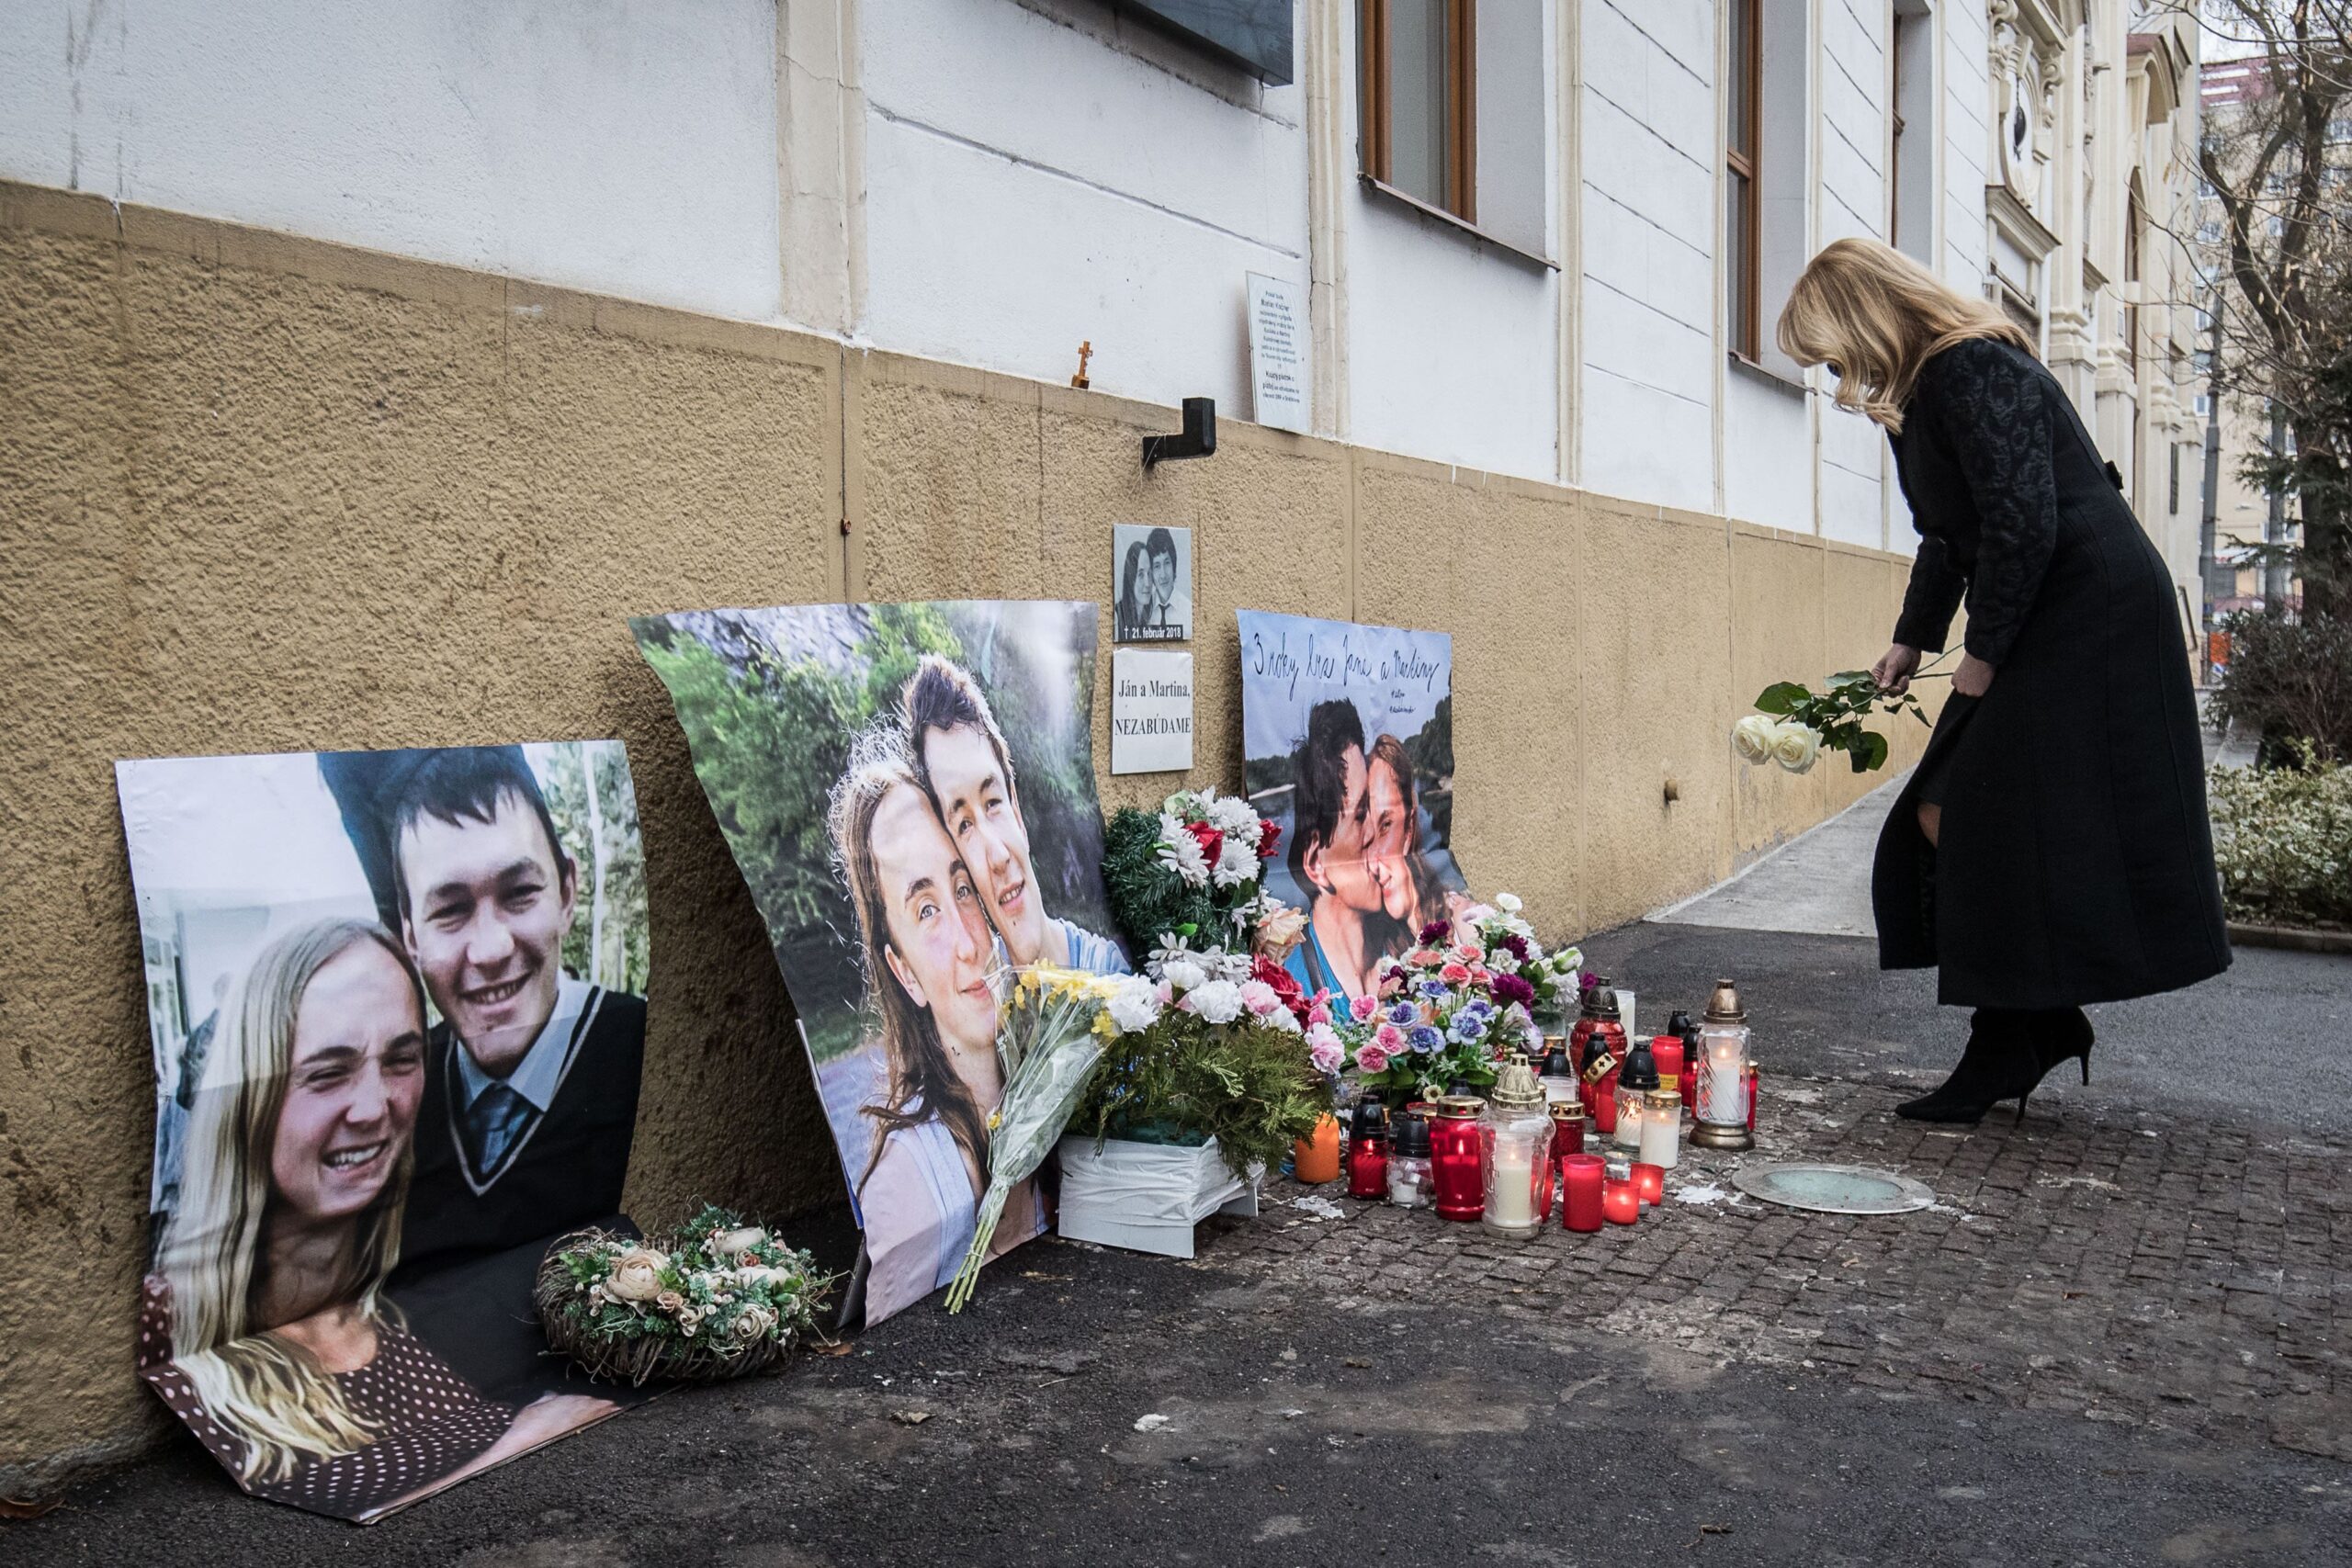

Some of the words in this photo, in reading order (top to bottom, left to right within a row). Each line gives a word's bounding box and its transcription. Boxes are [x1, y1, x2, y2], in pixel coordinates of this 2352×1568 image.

[1132, 627, 1142, 639] 21.
[1143, 626, 1165, 639] február
[1166, 626, 1182, 638] 2018
[1253, 632, 1264, 675] 3
[1380, 660, 1390, 681] a
[1118, 679, 1137, 698] Ján
[1140, 684, 1147, 698] a
[1149, 680, 1191, 699] Martina,
[1114, 713, 1192, 736] NEZABÚDAME
